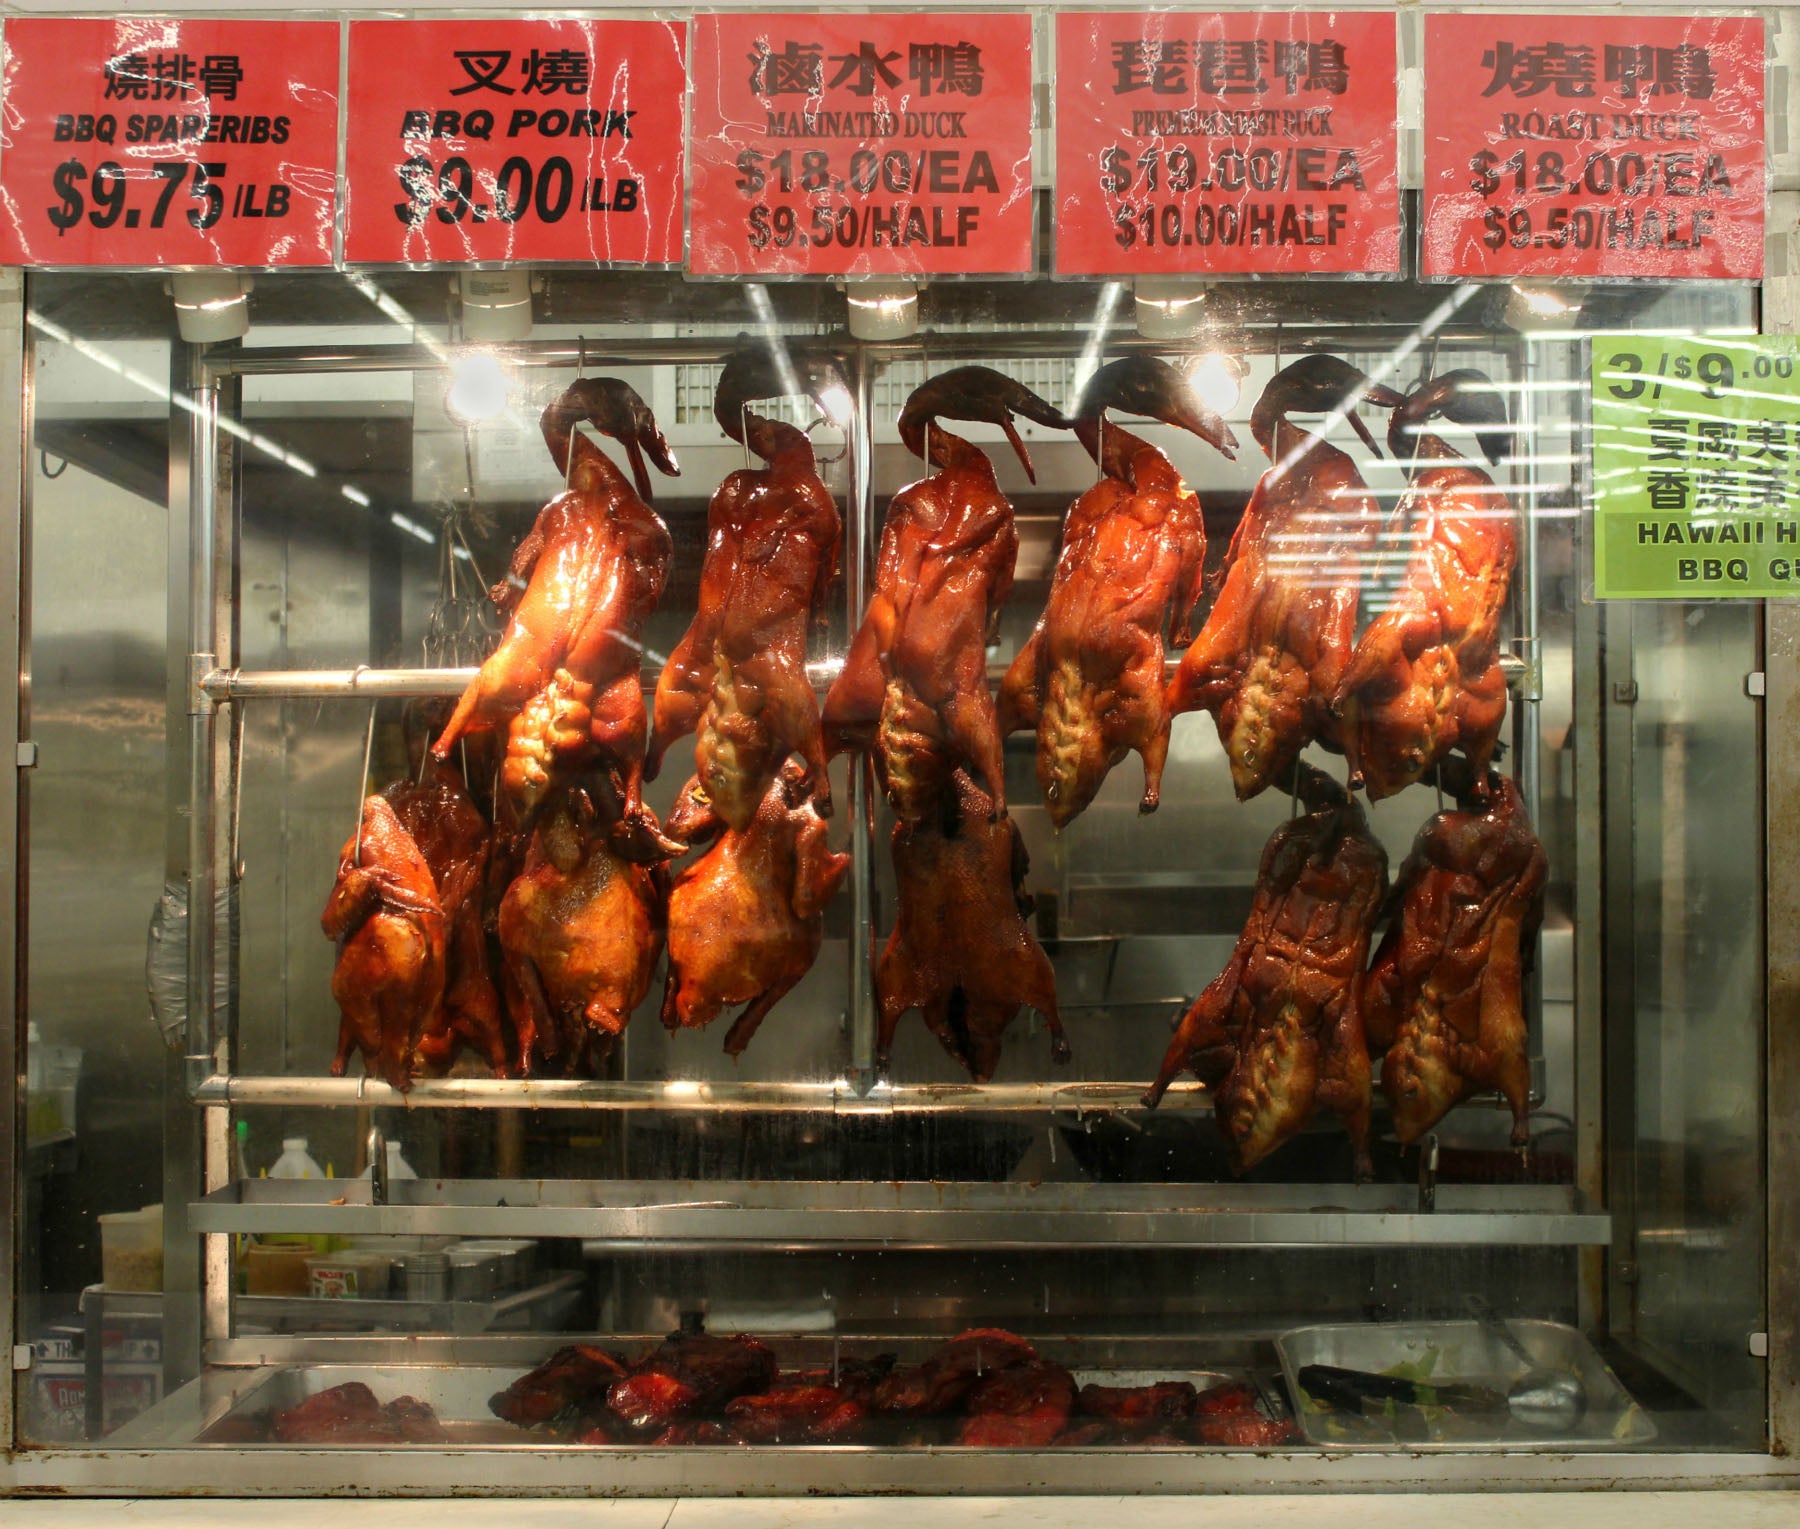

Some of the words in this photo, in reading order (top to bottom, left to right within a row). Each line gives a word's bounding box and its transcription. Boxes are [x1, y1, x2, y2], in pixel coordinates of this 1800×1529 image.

[104, 53, 243, 101] 燒排骨
[450, 49, 589, 96] 叉燒
[1111, 39, 1349, 95] 琵琶鴨
[1481, 41, 1716, 100] 燒鴨
[54, 114, 117, 145] BBQ
[125, 115, 291, 144] SPARERIBS
[400, 110, 494, 141] BBQ
[507, 110, 637, 138] PORK
[904, 112, 967, 138] DUCK
[1283, 110, 1333, 136] DUCK
[1502, 113, 1604, 140] ROAST
[735, 148, 1000, 199] $18.00/EA
[1102, 146, 1366, 193] $19.00/EA
[748, 206, 979, 252] $9.50/HALF
[1115, 203, 1346, 251] $10.00/HALF
[1648, 418, 1800, 461] 夏威夷
[1638, 521, 1764, 544] HAWAII
[1679, 559, 1749, 582] BBQ
